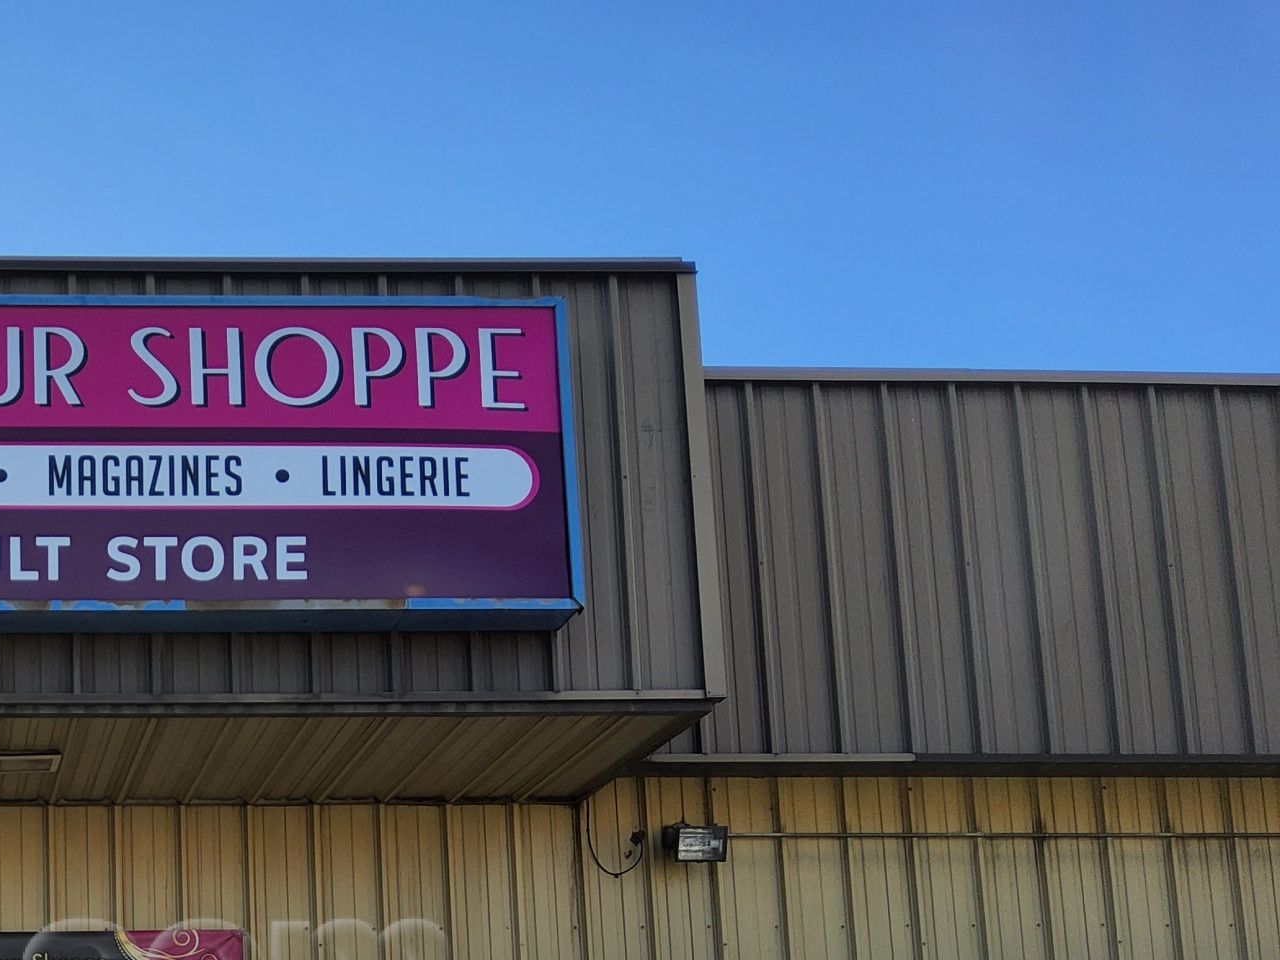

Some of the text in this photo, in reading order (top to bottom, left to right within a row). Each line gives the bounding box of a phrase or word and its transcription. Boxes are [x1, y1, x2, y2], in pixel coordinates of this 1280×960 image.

[125, 324, 531, 412] SHOPPE
[47, 454, 243, 498] MAGAZINES
[320, 456, 471, 498] LINGERIE
[105, 535, 309, 582] STORE
